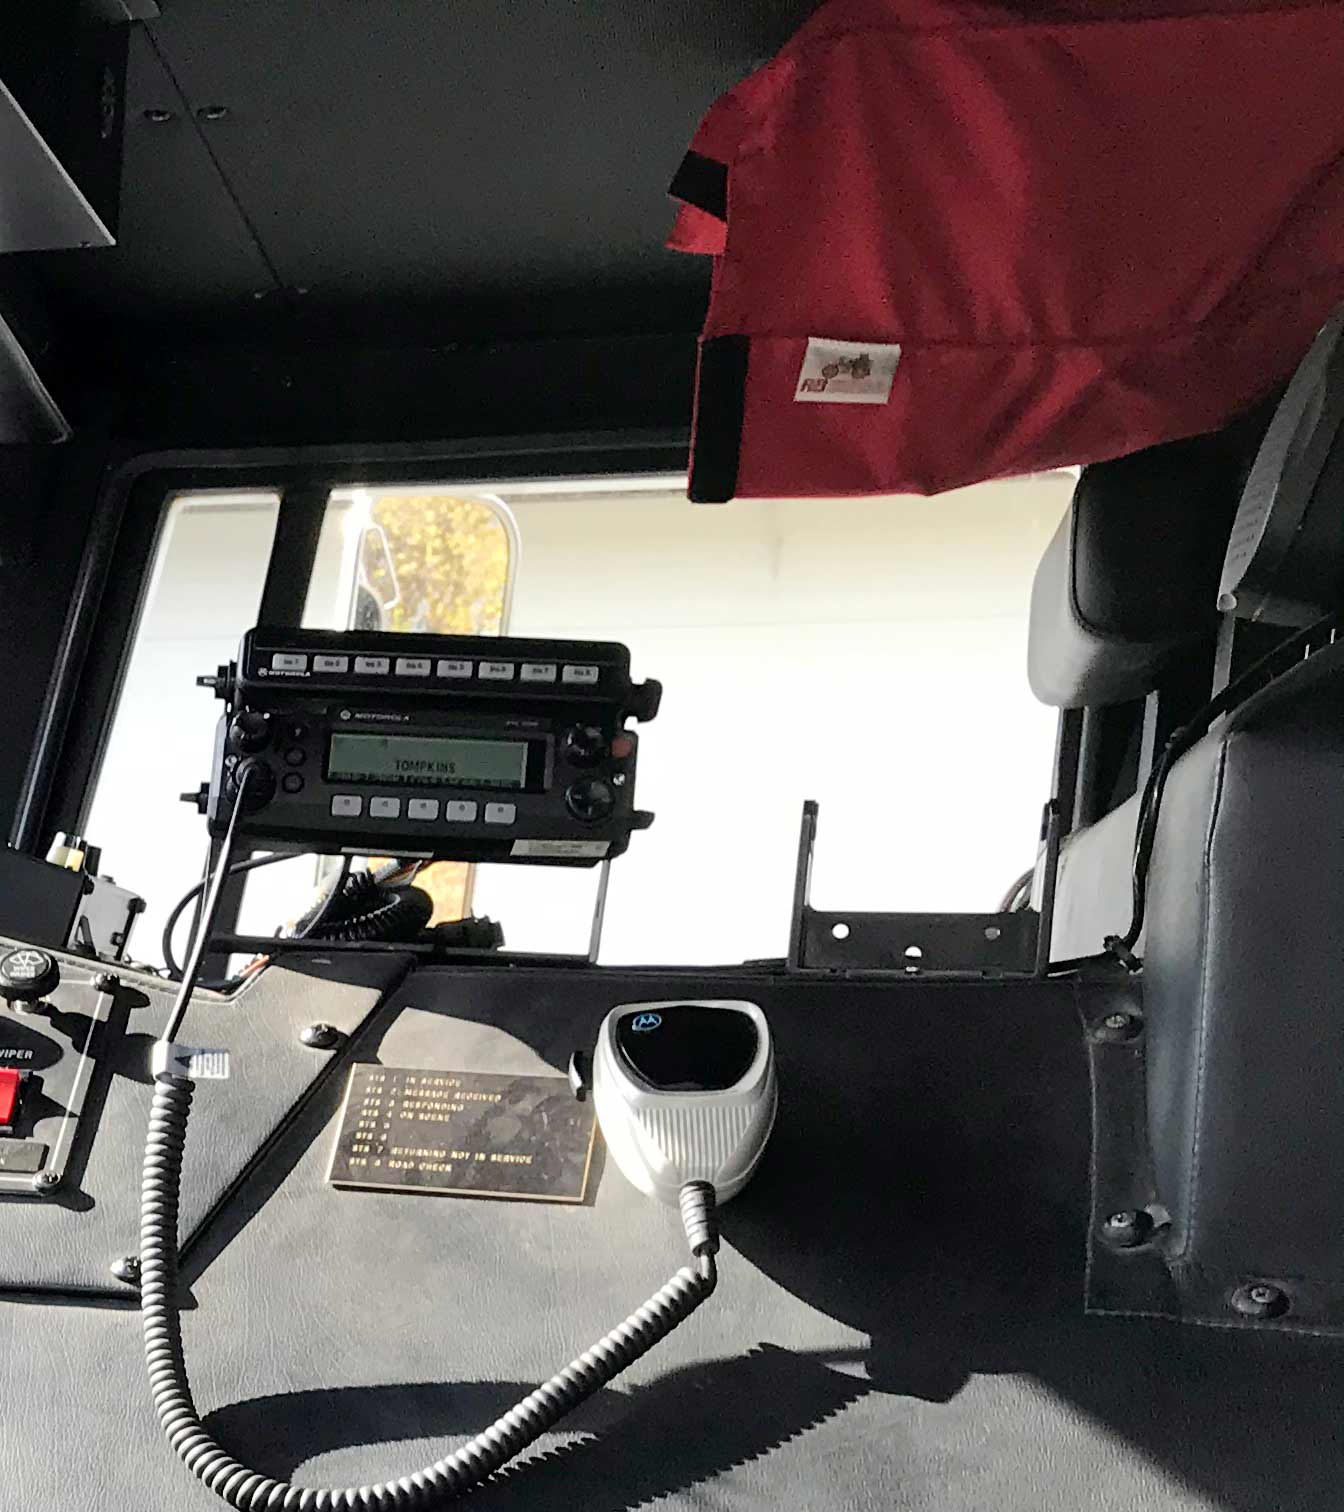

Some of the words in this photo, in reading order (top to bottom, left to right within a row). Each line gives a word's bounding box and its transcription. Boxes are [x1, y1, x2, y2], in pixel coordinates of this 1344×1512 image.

[395, 760, 456, 774] TOMPKINS
[421, 1077, 461, 1088] SERVICE
[404, 1088, 449, 1099] MESSAGE
[454, 1091, 502, 1103] RECEIVED
[402, 1100, 464, 1112] RESPONDING
[399, 1111, 414, 1120] ON
[418, 1112, 450, 1122] SCENE
[390, 1147, 446, 1158] RETURNING
[451, 1151, 470, 1161] NOT
[474, 1152, 486, 1161] IN
[490, 1153, 533, 1164] SERVICE
[388, 1160, 414, 1169] ROAD
[419, 1162, 452, 1172] CHECK
